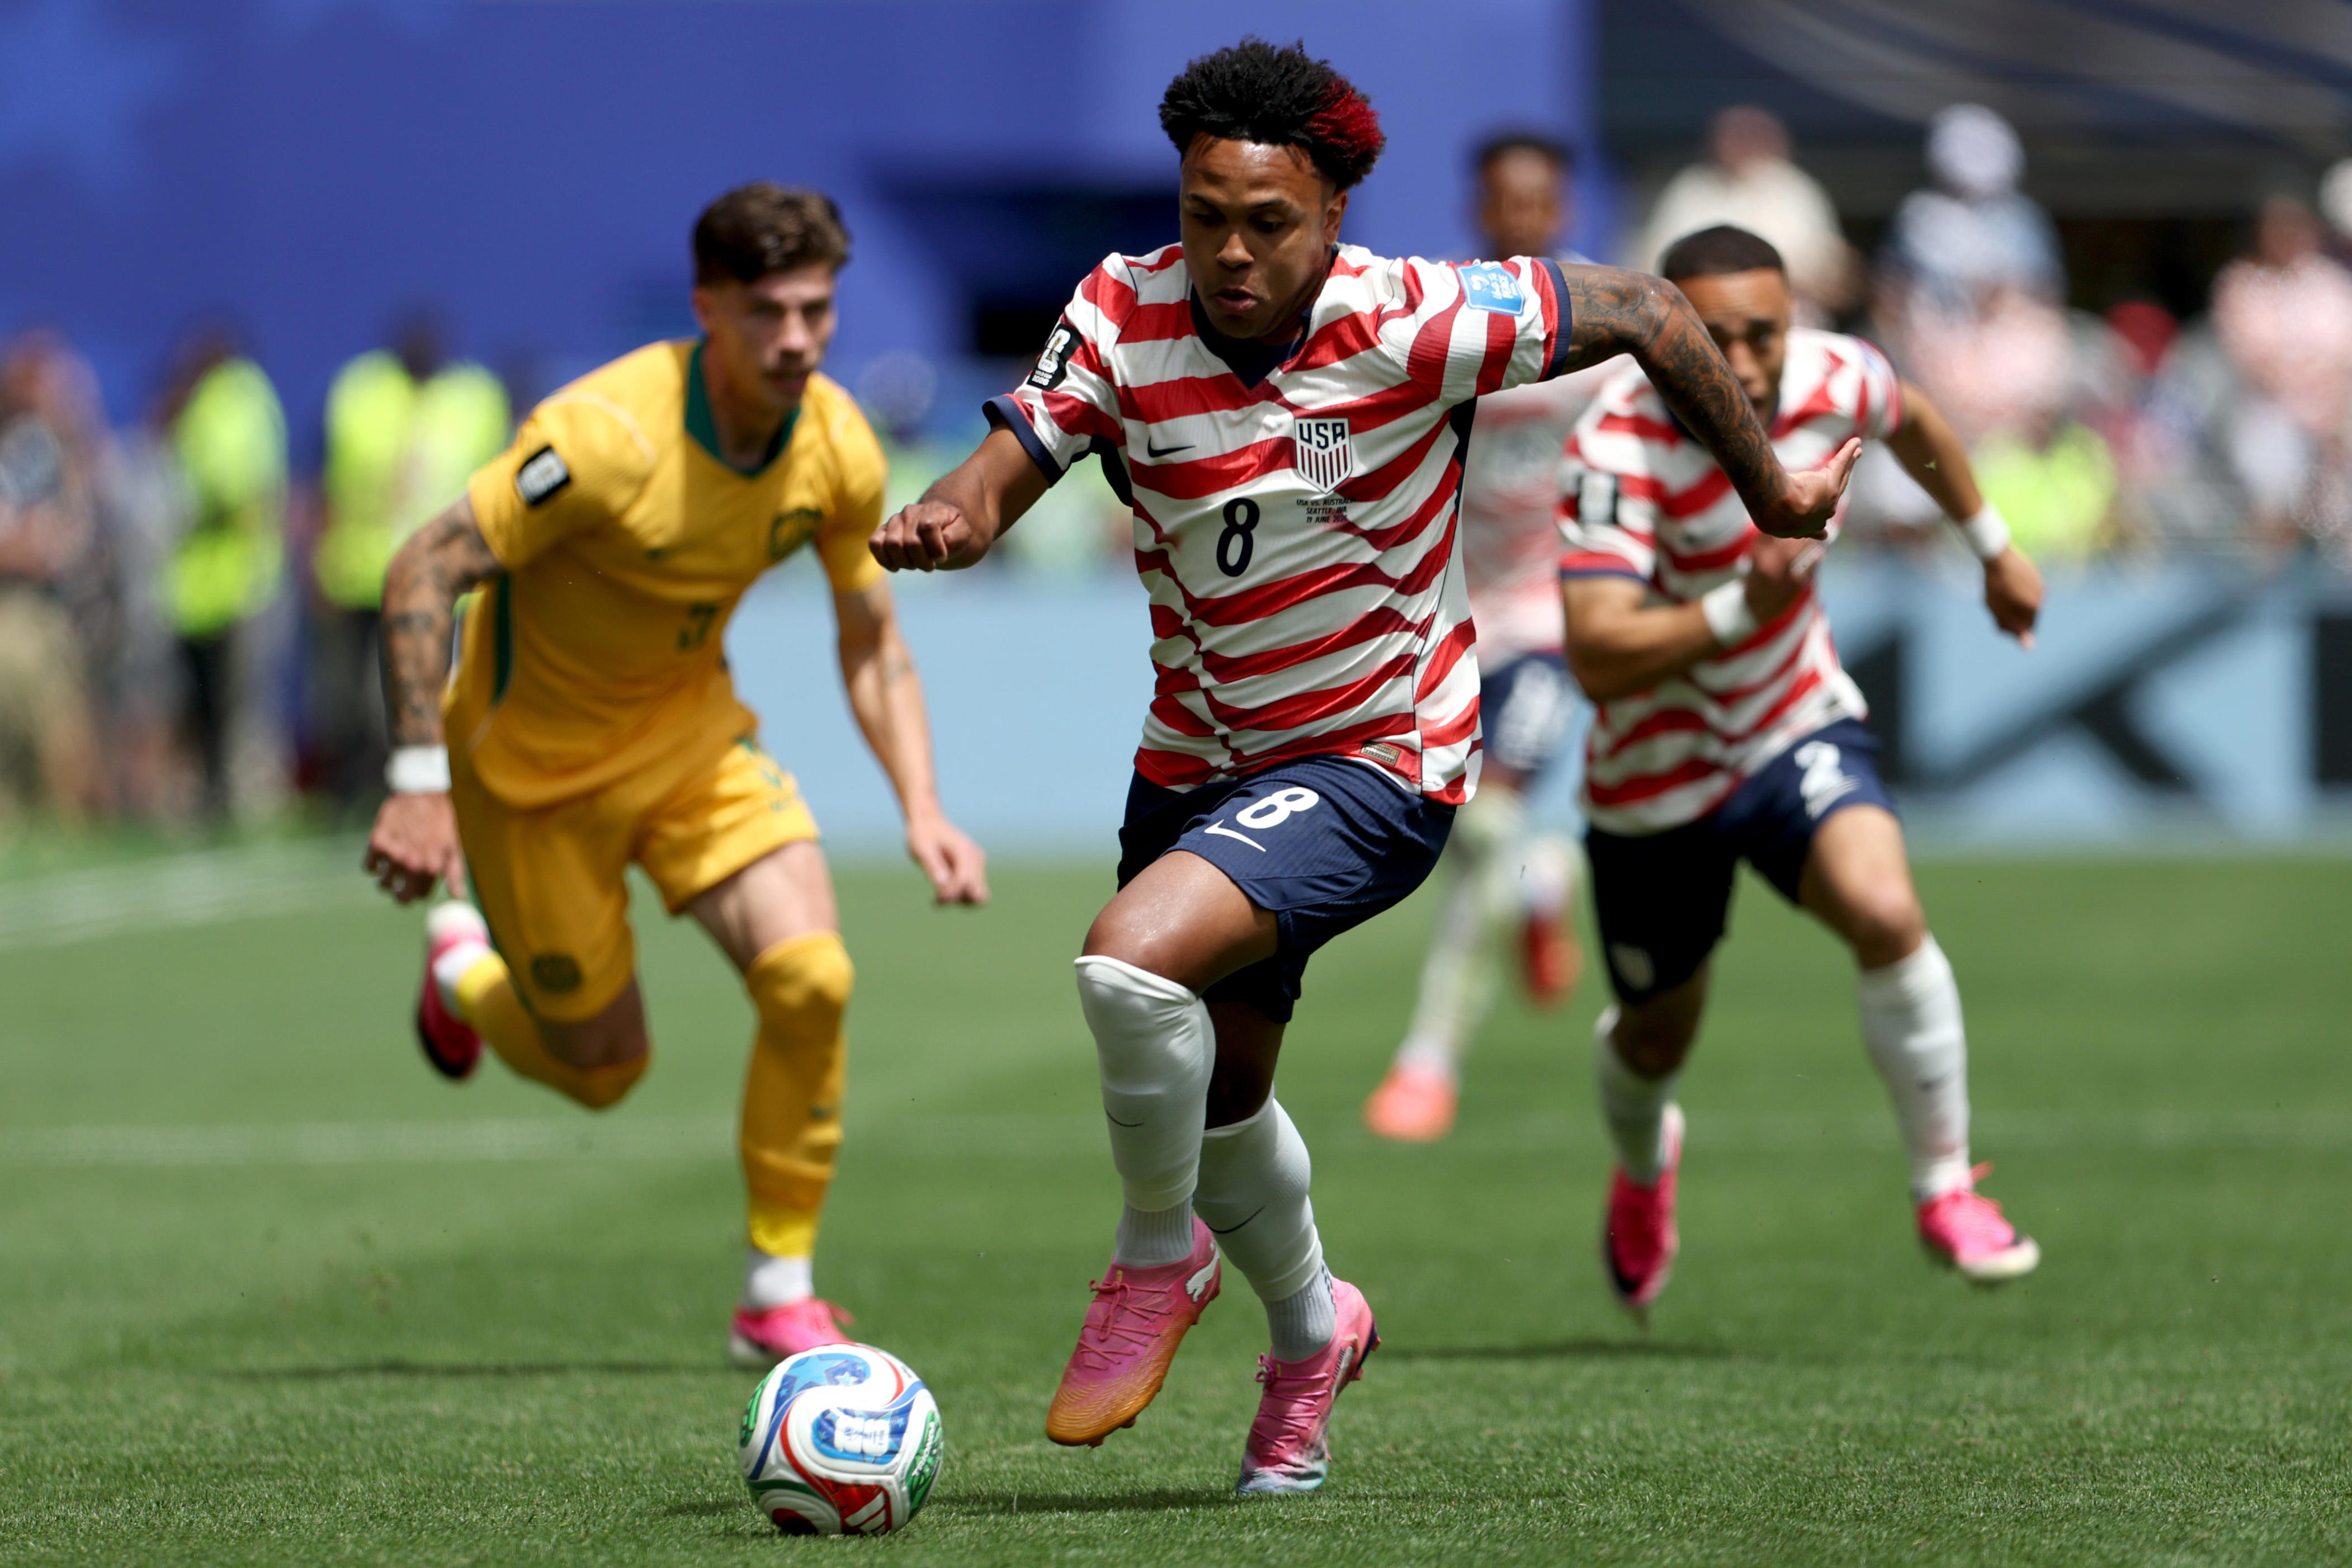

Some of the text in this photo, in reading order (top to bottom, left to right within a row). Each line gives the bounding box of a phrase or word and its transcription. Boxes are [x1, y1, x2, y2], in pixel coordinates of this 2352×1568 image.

[1032, 374, 1050, 386] 2026
[1298, 422, 1346, 450] USA
[1323, 497, 1356, 506] AUSTRALIA
[1216, 497, 1260, 578] 8
[1794, 739, 1850, 805] 2
[1235, 786, 1320, 829] 8
